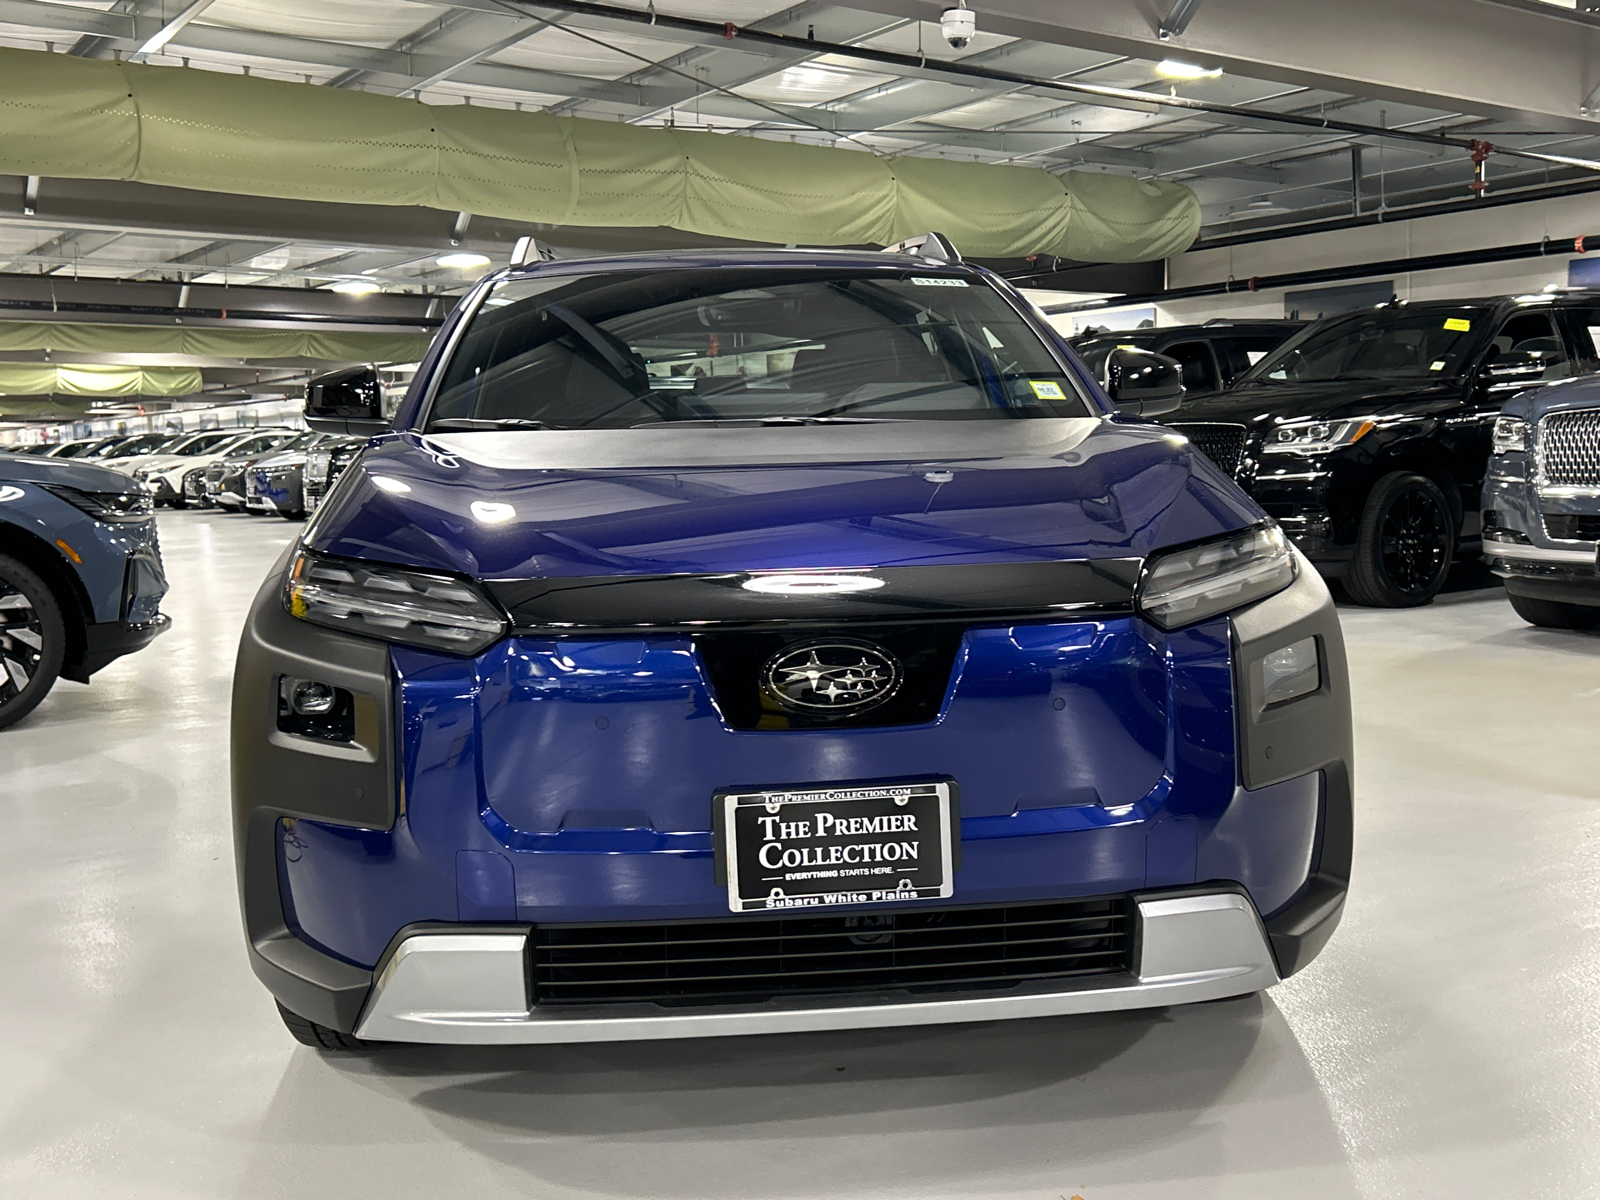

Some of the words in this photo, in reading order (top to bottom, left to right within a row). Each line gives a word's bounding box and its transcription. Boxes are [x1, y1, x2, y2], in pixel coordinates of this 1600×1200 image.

[758, 815, 811, 841] THE
[814, 812, 919, 837] PREMIER
[758, 841, 919, 869] COLLECTION
[785, 869, 838, 881] EVERYTHING
[839, 867, 869, 877] STARTS
[870, 866, 894, 875] HERE.
[765, 896, 819, 908] Subaru
[823, 893, 867, 903] White
[872, 890, 918, 901] Plains
